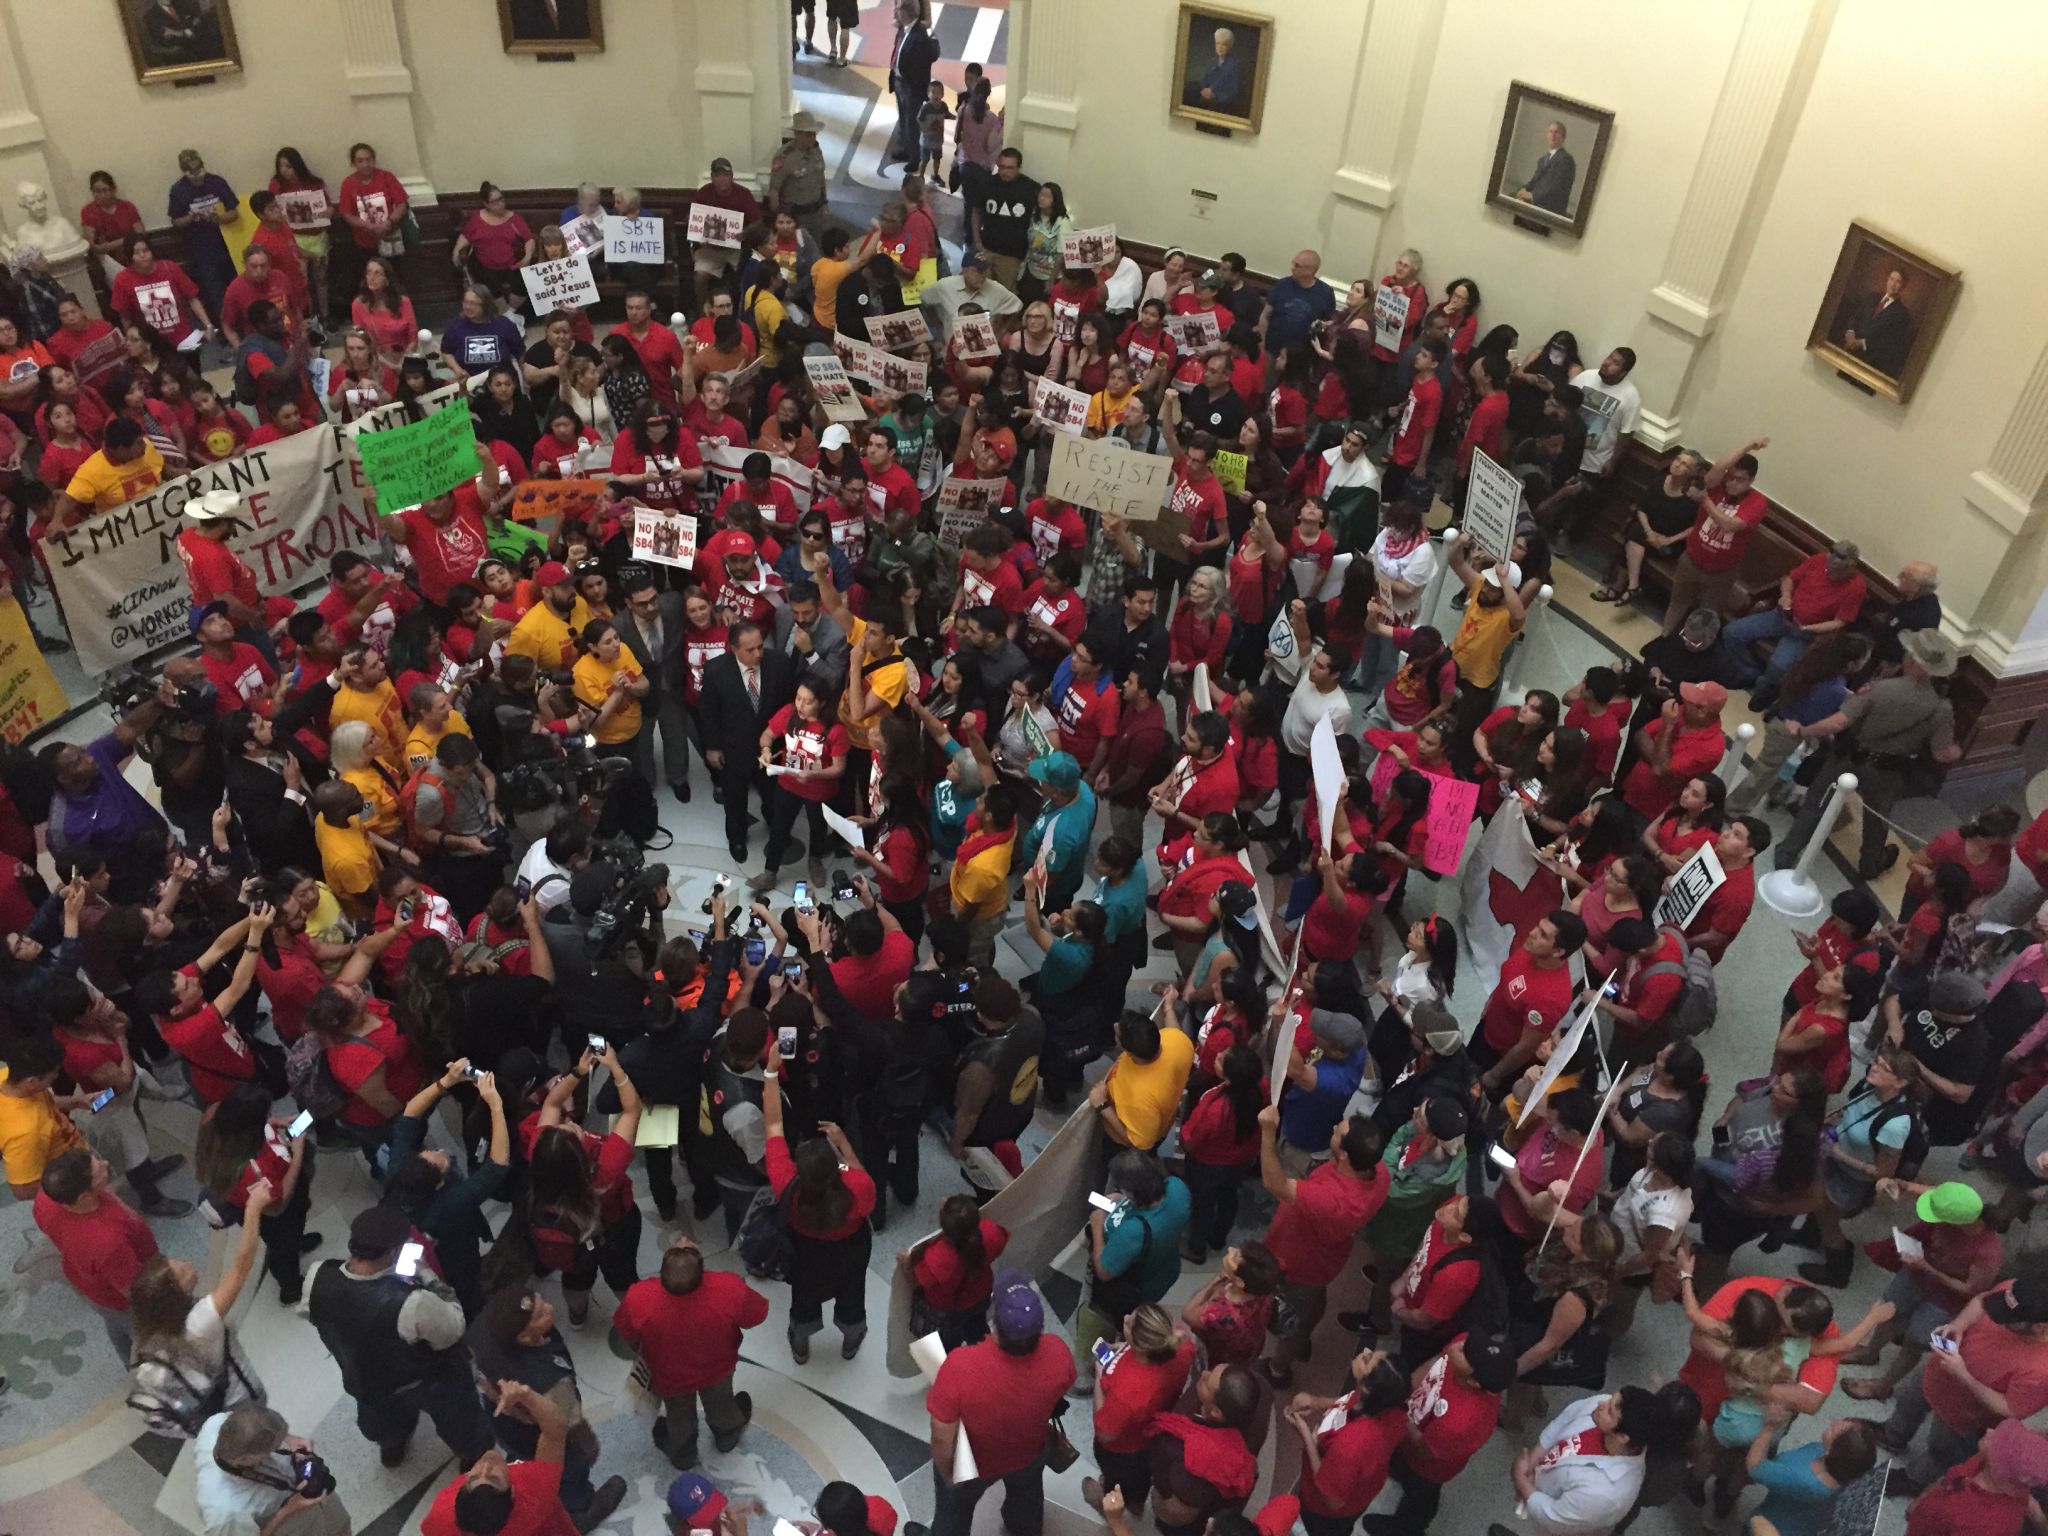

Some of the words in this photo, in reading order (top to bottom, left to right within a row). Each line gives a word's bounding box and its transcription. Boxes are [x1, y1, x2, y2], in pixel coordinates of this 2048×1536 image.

[692, 214, 703, 223] NO
[622, 218, 655, 236] SB4
[614, 241, 626, 254] IS
[631, 241, 661, 254] HATE
[1065, 242, 1077, 250] NO
[566, 259, 579, 268] do
[535, 287, 557, 300] said
[561, 281, 591, 294] Jesus
[552, 294, 581, 307] never
[910, 372, 923, 380] NO
[1071, 402, 1085, 413] NO
[1066, 415, 1083, 426] SB4
[1065, 440, 1164, 486] RESIST
[944, 487, 958, 496] NO
[1093, 478, 1122, 493] THE
[1476, 473, 1494, 491] BLACK
[1494, 487, 1510, 506] LIVES
[1063, 481, 1144, 515] HATE
[1480, 488, 1503, 510] MATTER
[60, 451, 271, 567] IMMIGRANT
[944, 519, 959, 527] NO
[639, 522, 652, 534] NO
[682, 530, 694, 542] NO
[635, 537, 653, 549] SB4
[679, 545, 693, 557] SB4
